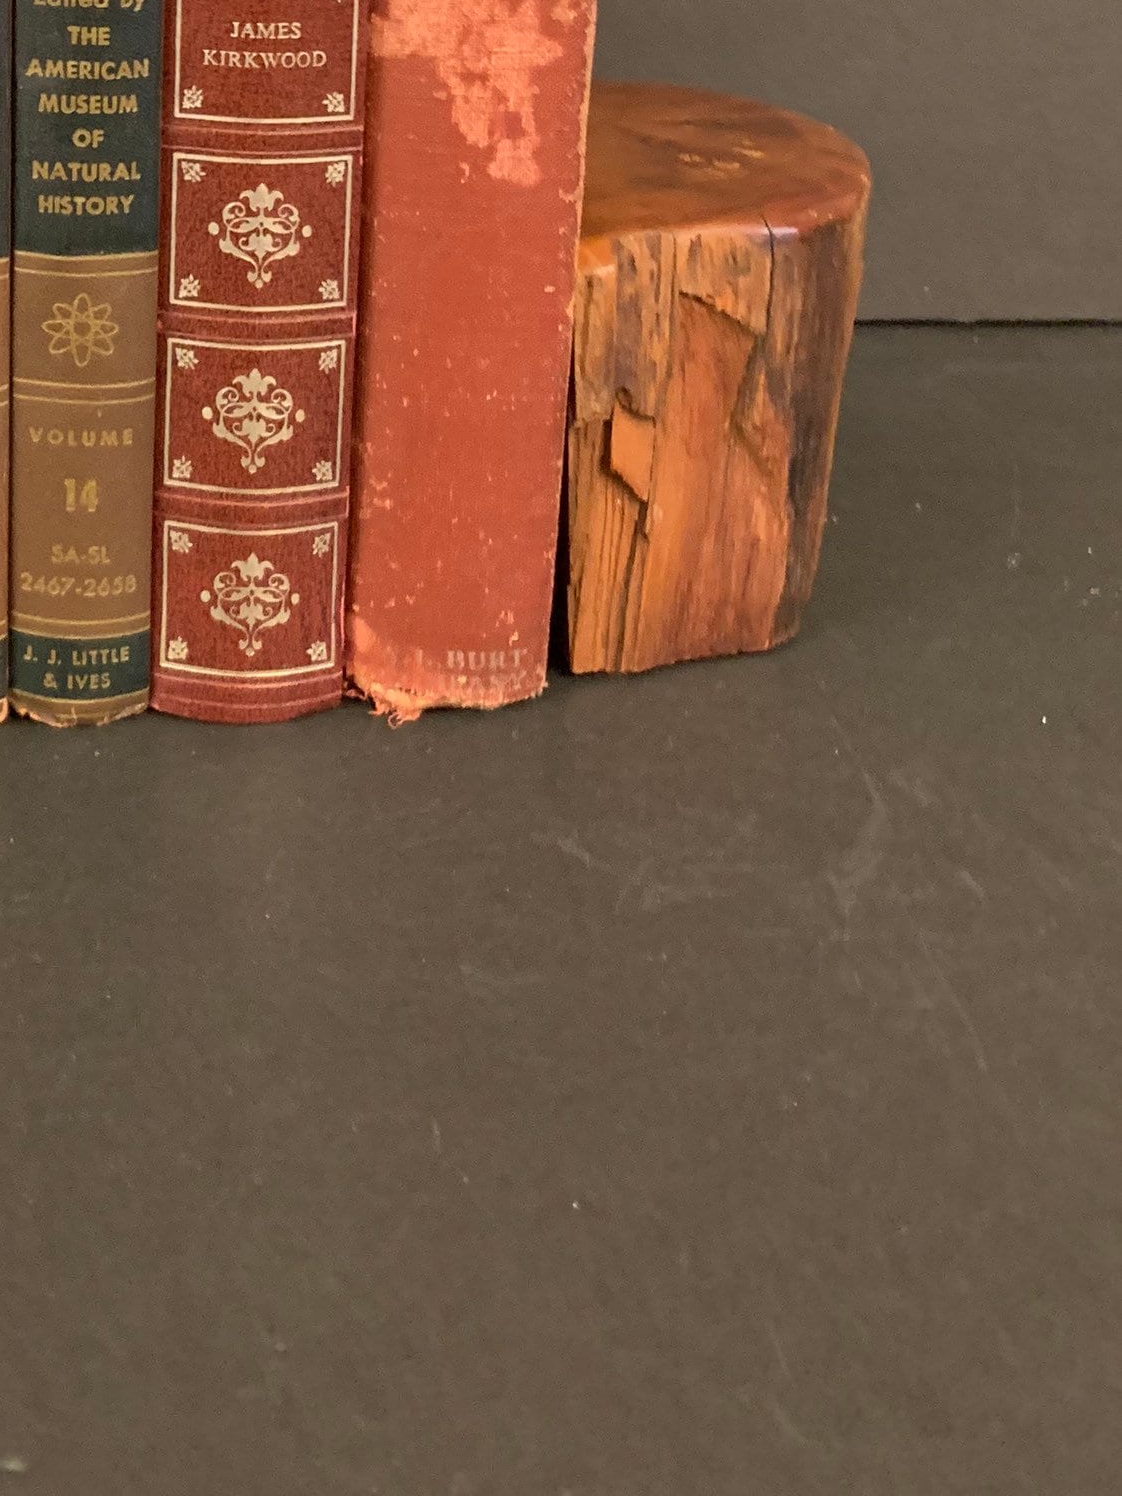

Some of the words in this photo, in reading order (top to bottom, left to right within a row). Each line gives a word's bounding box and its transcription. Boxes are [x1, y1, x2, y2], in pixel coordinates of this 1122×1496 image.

[67, 25, 112, 47] THE
[229, 20, 303, 40] JAMES
[25, 57, 151, 82] AMERICAN
[202, 48, 328, 70] KIRKWOOD
[37, 92, 139, 115] MUSEUM
[71, 128, 106, 149] OF
[31, 159, 142, 183] NATURAL
[37, 193, 136, 217] HISTORY
[28, 425, 134, 448] VOLUME
[63, 477, 100, 513] 14
[71, 645, 131, 665] LITTLE
[42, 672, 58, 690] &
[66, 671, 112, 691] IVES
